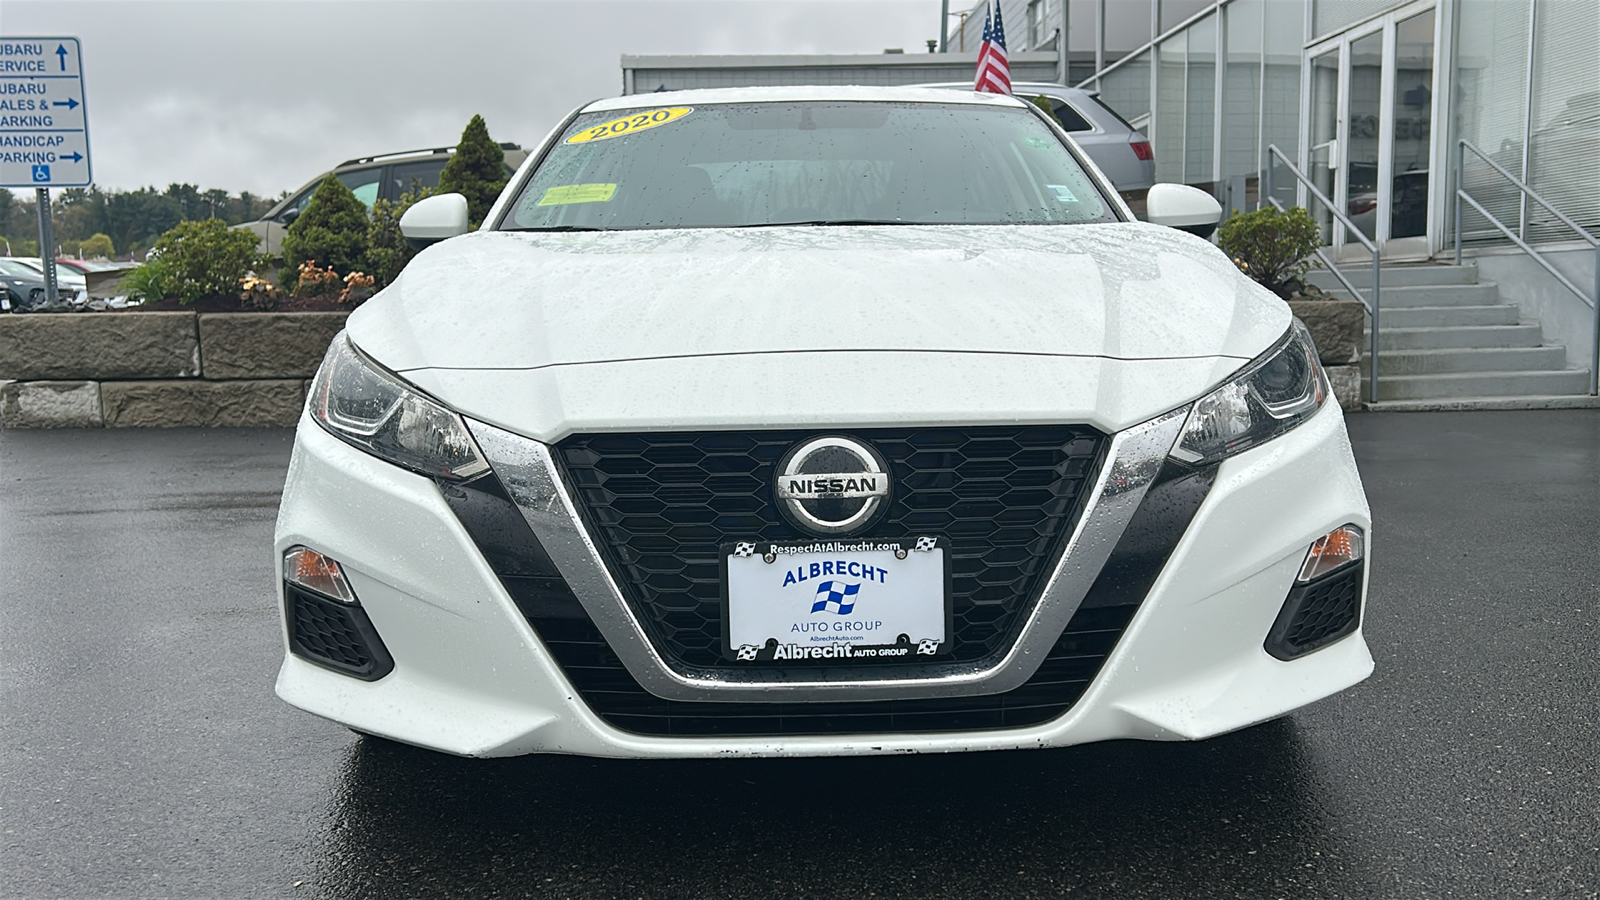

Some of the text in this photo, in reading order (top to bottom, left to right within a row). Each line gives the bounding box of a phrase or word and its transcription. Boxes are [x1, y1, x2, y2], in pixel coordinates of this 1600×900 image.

[40, 100, 48, 110] &
[590, 110, 670, 139] 2020
[790, 478, 876, 493] NISSAN
[770, 541, 901, 556] RespectAtAlbrecht.com
[782, 560, 889, 588] ALBRECHT
[790, 620, 882, 632] AUTO GROUP
[773, 642, 909, 660] Albrecht AUTO GROUP
